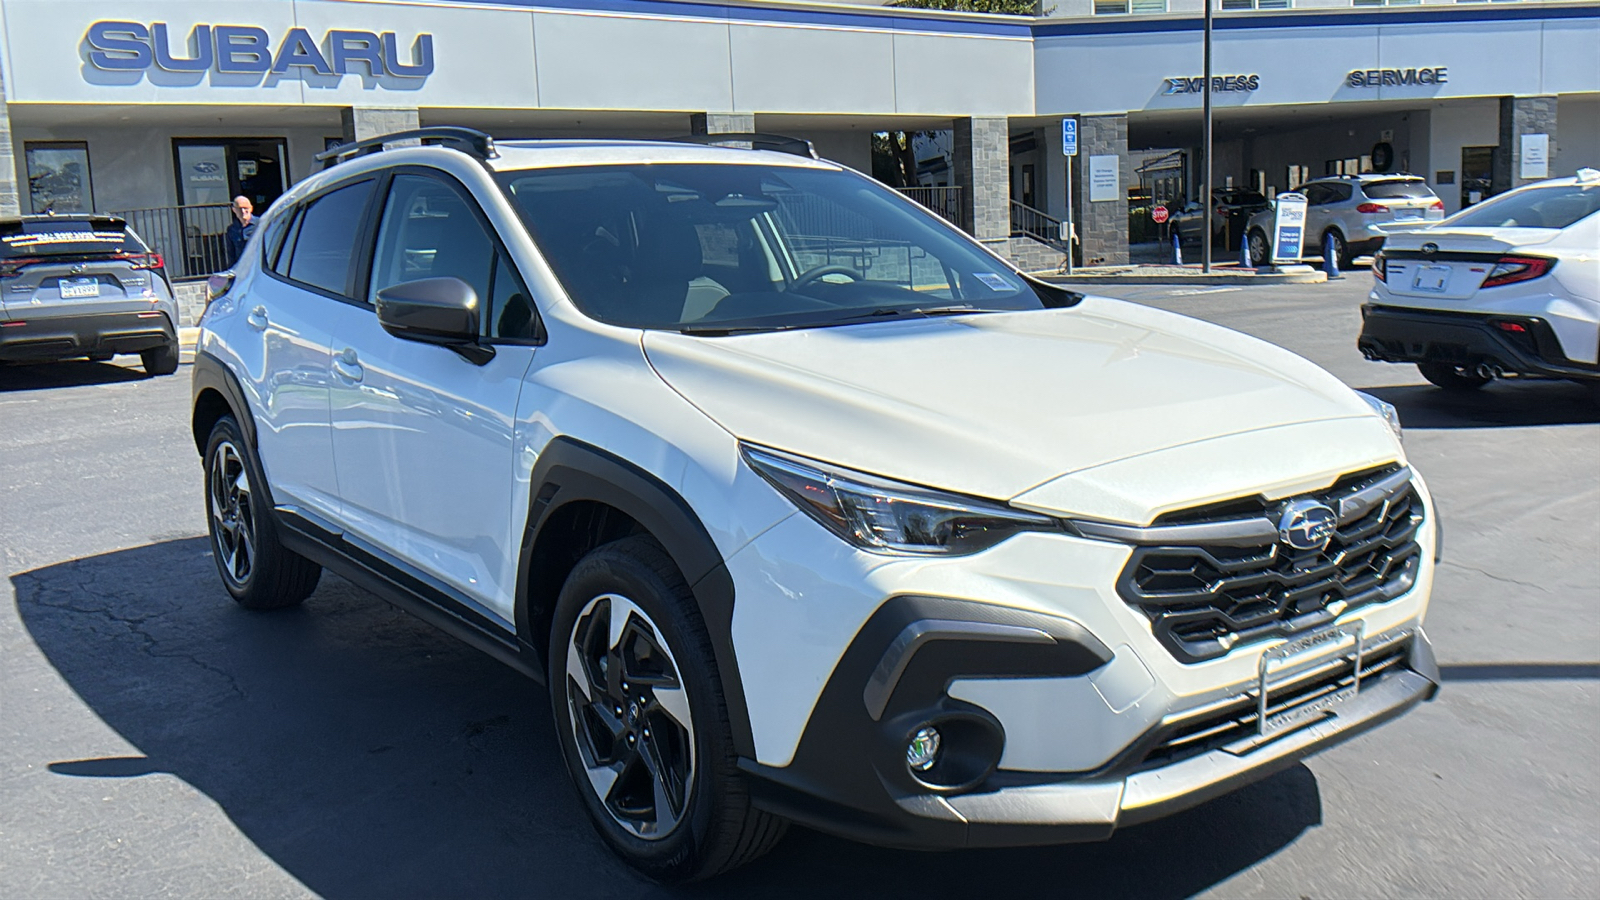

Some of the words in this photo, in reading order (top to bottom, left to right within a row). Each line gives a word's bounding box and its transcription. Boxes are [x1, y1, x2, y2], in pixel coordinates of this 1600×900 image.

[85, 21, 435, 78] SUBARU
[1349, 67, 1448, 88] SERVICE
[1153, 210, 1168, 218] STOP
